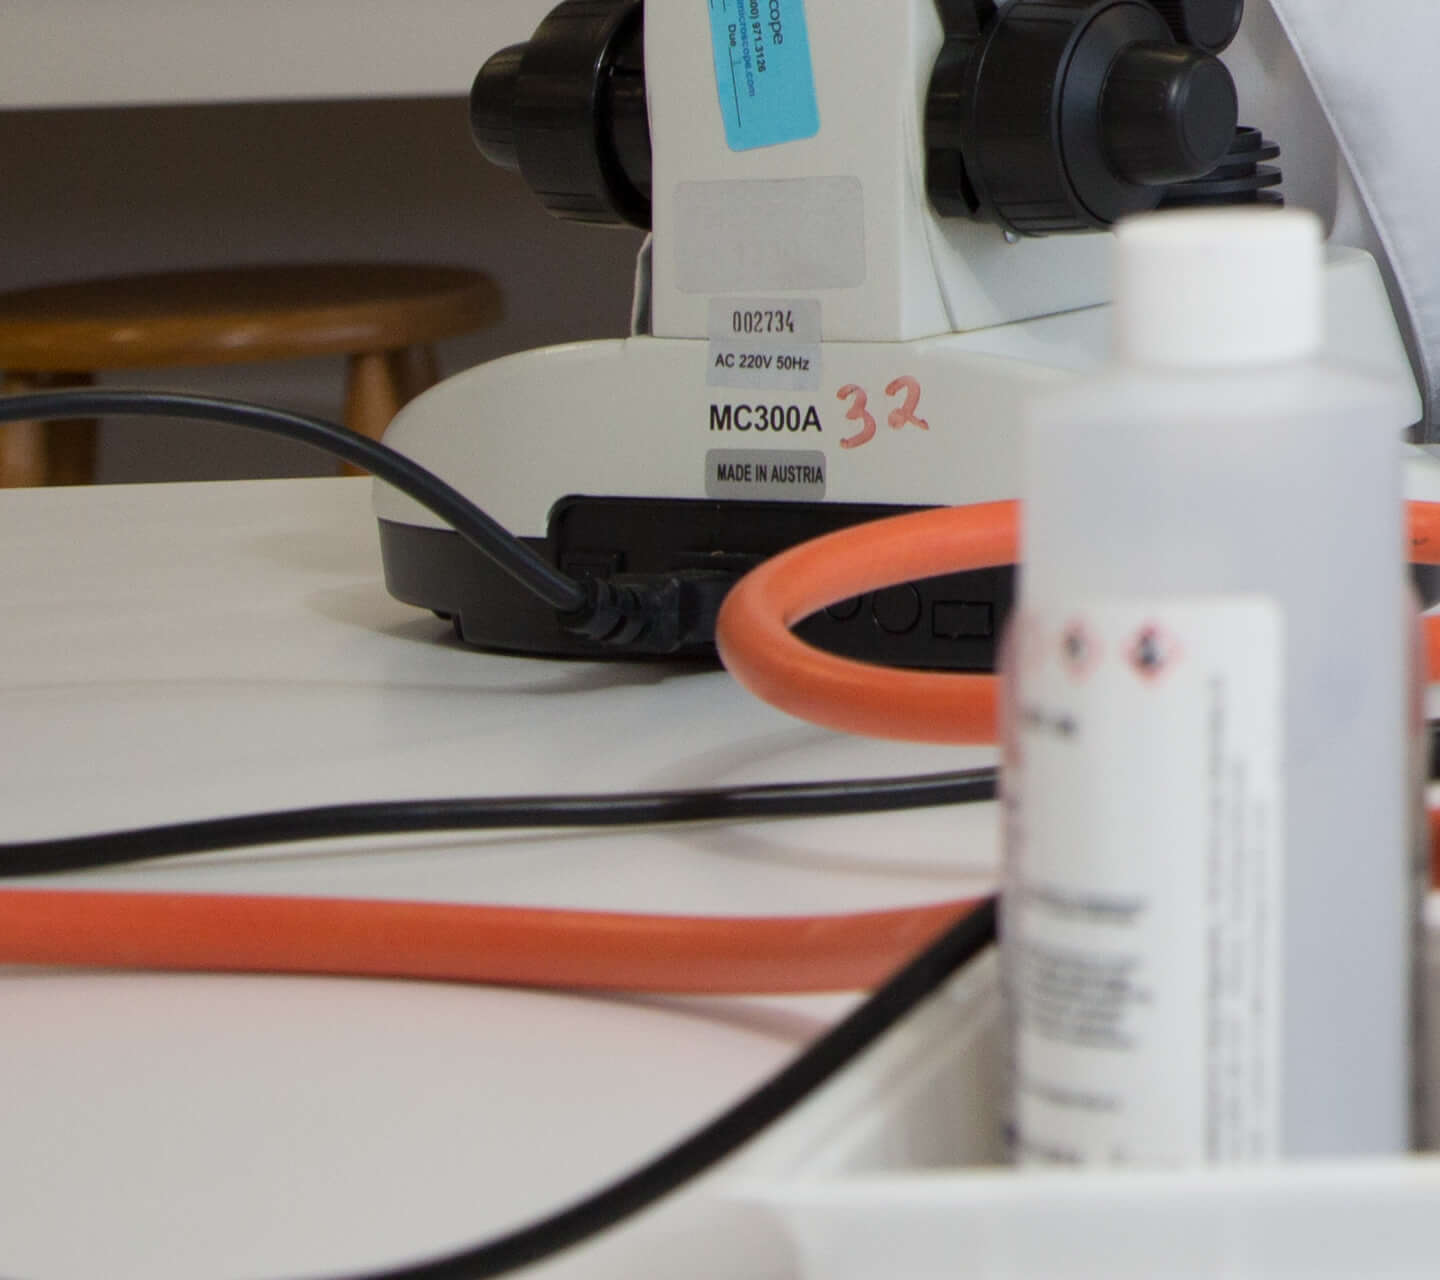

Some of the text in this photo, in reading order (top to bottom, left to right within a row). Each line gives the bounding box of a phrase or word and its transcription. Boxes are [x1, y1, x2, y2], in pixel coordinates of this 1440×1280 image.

[728, 23, 736, 47] Due
[733, 309, 794, 334] 002734
[715, 352, 810, 371] AC 220V 50Hz
[709, 404, 822, 432] MC300A
[836, 375, 929, 449] 32
[717, 464, 824, 484] MADE IN AUSTRIA
